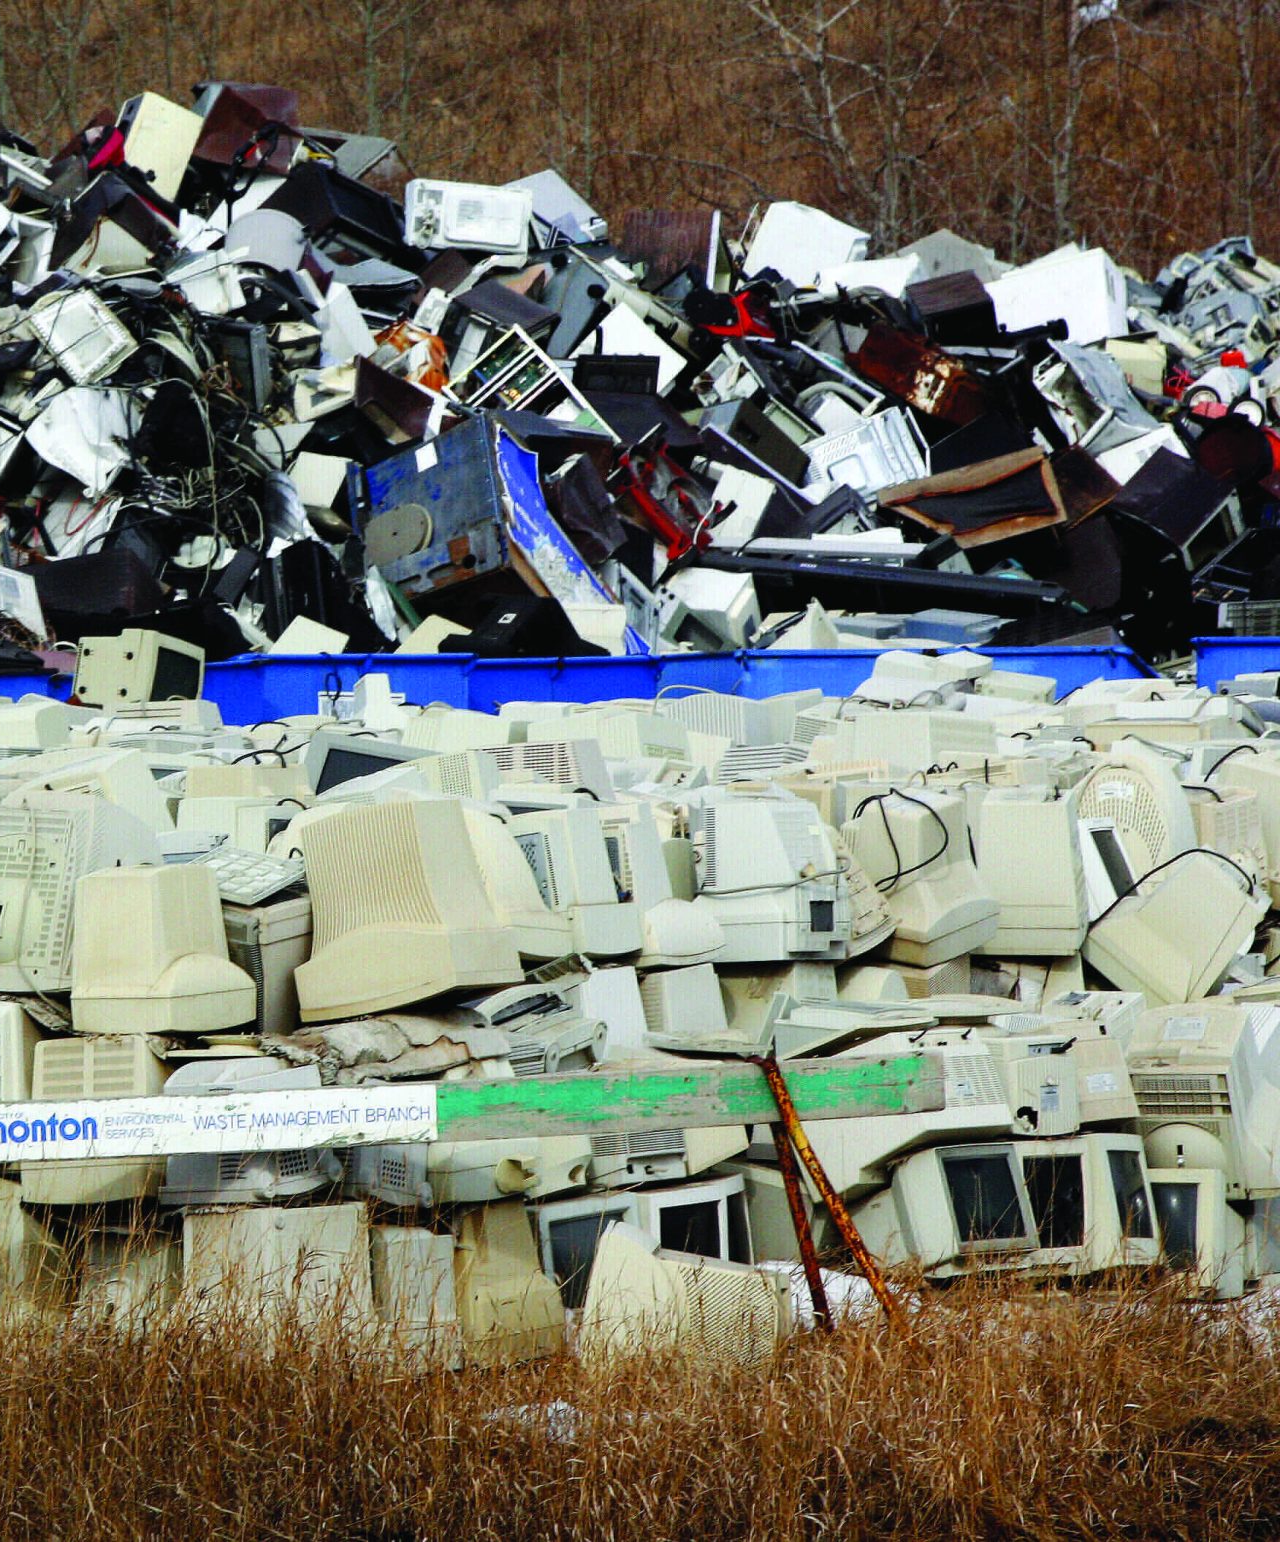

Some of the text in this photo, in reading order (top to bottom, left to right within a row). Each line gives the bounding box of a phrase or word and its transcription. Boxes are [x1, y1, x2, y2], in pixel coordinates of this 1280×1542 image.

[193, 1105, 431, 1130] WASTE MANAGEMENT BRANCH
[105, 1127, 155, 1139] SERVICES
